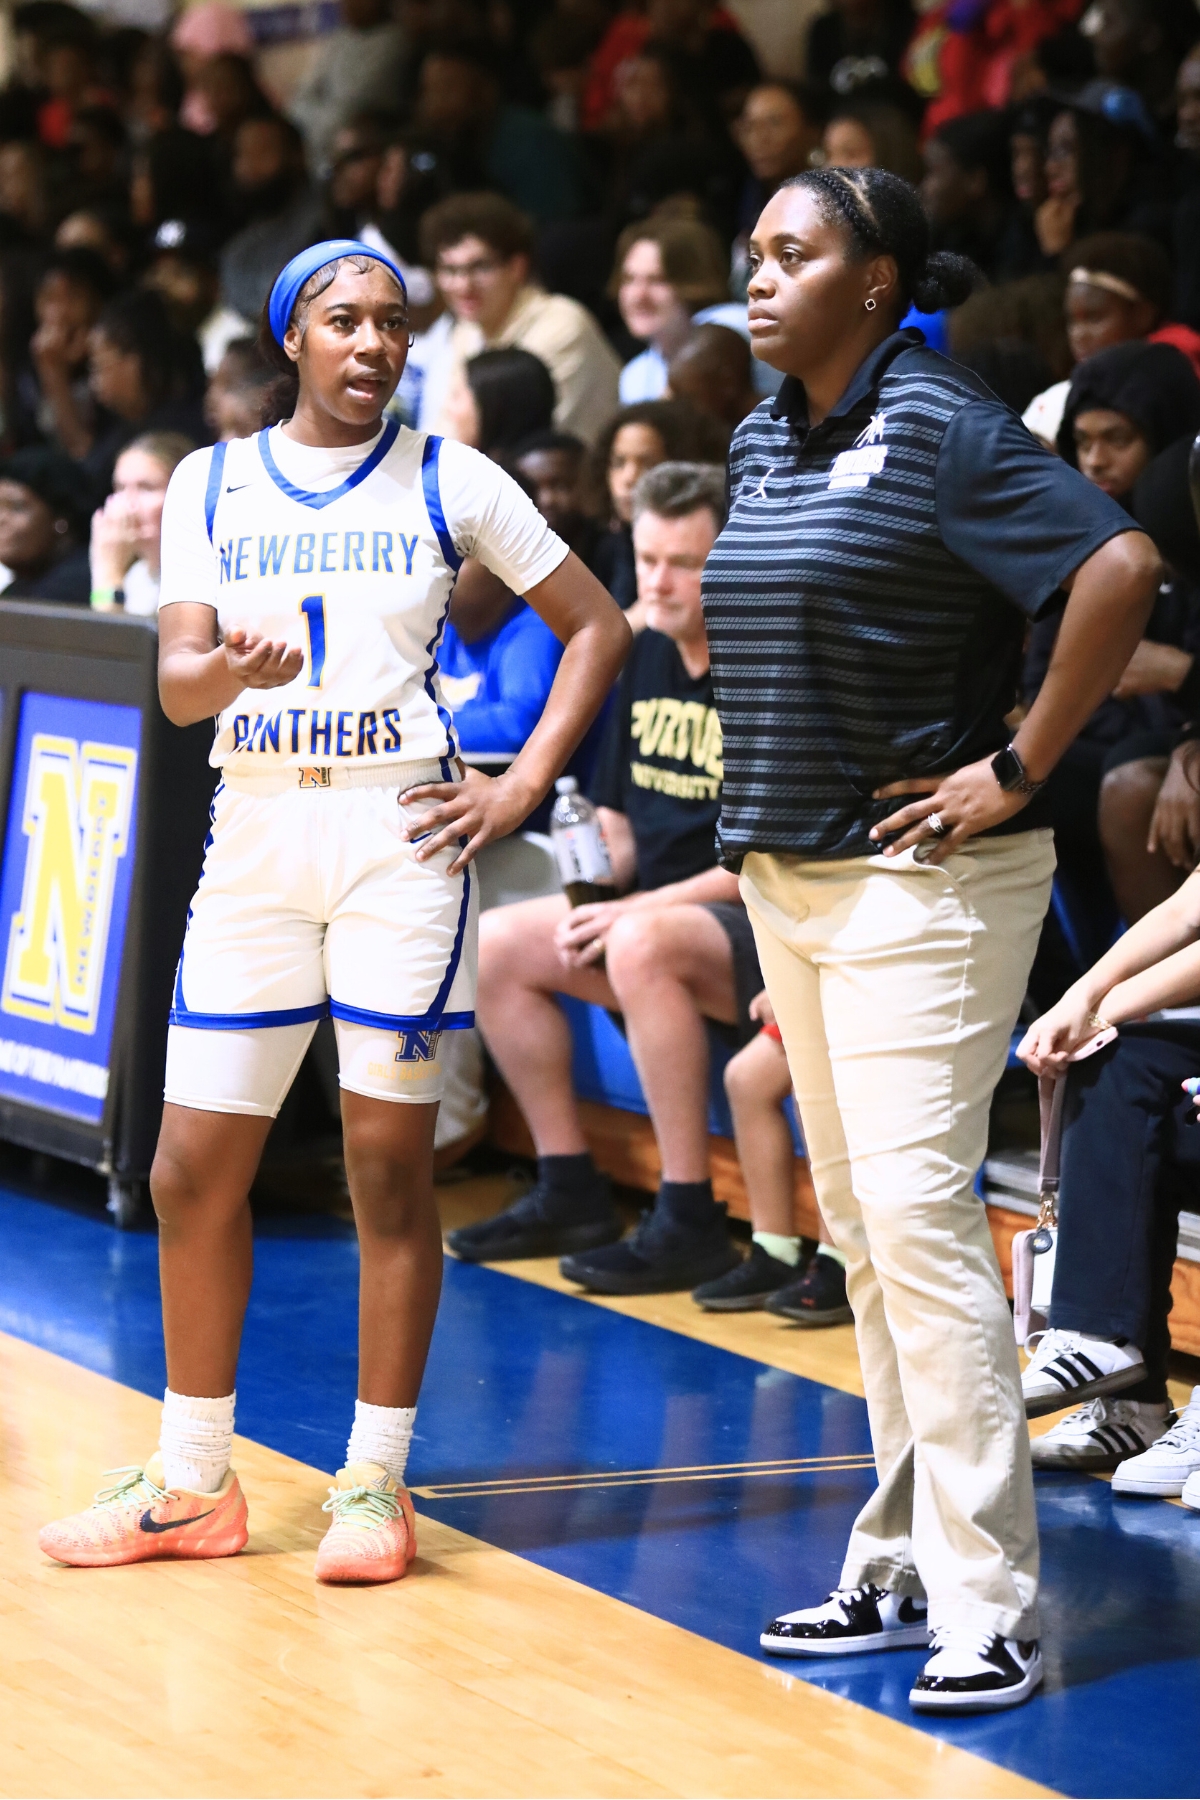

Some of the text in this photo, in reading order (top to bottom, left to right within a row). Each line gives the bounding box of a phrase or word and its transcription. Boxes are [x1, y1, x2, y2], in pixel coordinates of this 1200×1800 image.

[218, 530, 420, 585] NEWBERRY
[298, 592, 326, 691] 1
[1, 732, 138, 1036] N
[395, 1029, 442, 1062] N
